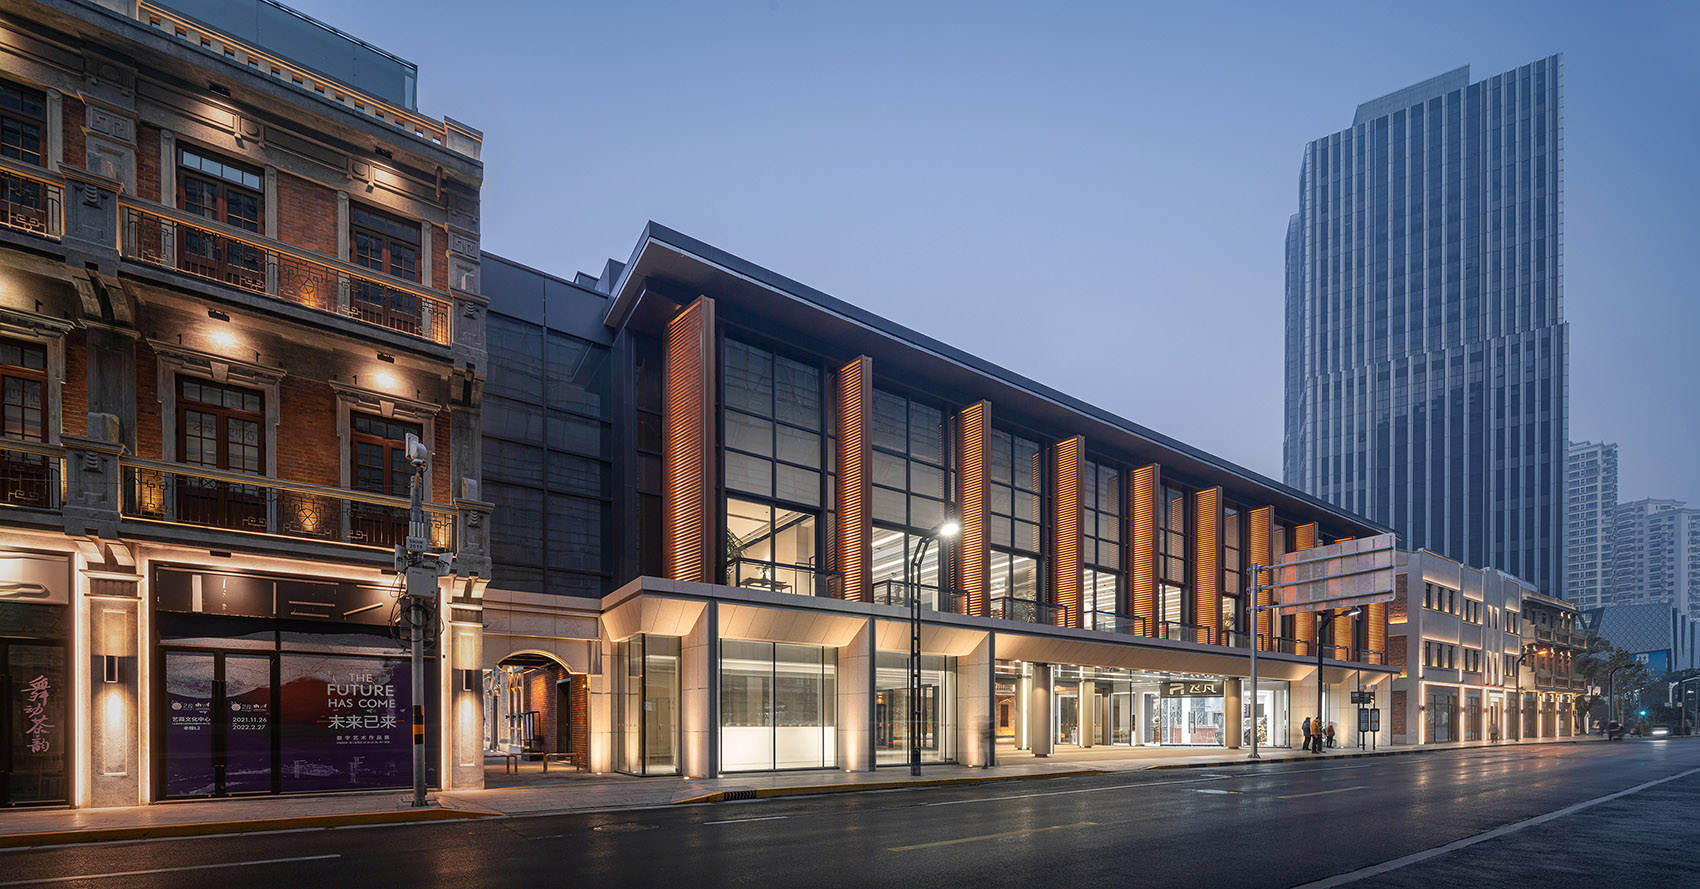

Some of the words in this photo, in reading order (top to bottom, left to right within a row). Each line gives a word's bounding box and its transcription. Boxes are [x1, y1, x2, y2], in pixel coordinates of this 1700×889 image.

[349, 673, 373, 682] THE
[327, 683, 394, 696] FUTURE
[1189, 683, 1217, 693] 飞凡
[328, 698, 353, 708] HAS
[358, 698, 396, 708] COME
[327, 714, 397, 729] 未来已来
